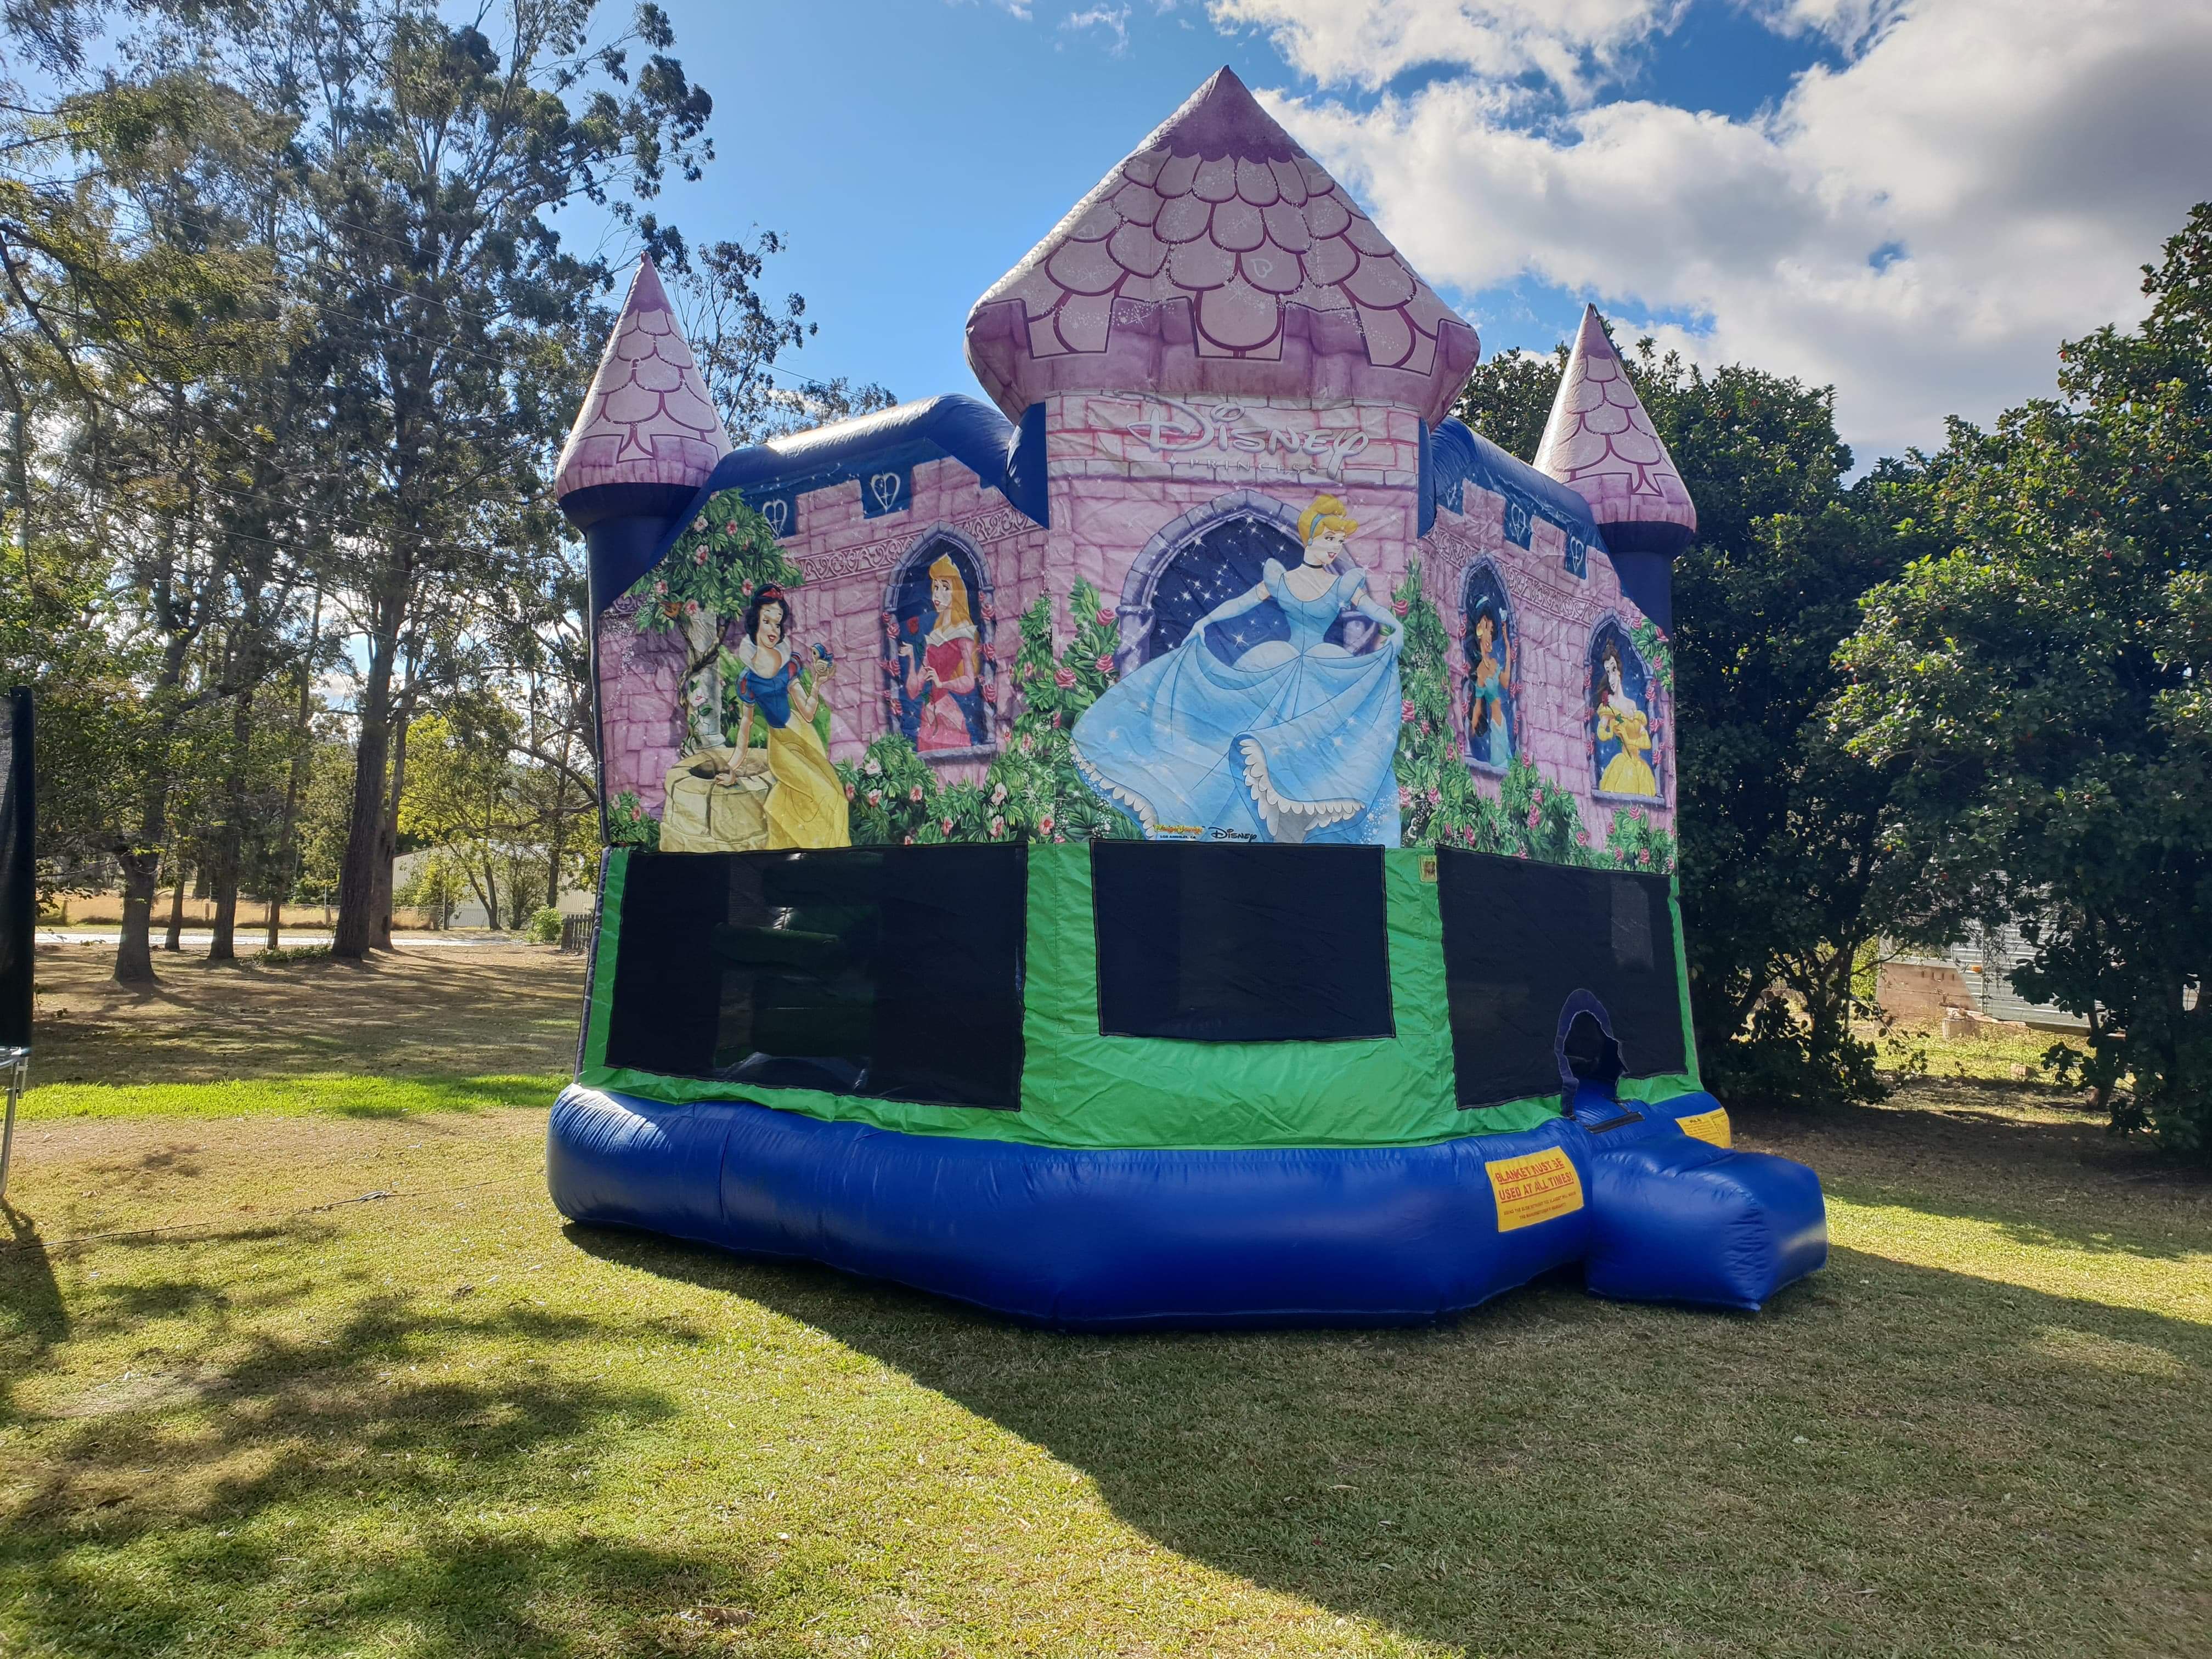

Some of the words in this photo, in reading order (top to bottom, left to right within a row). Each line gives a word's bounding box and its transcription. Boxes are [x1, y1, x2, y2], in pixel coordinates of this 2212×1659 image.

[1189, 458, 1318, 474] PRINCESS
[1495, 1166, 1531, 1183] BLANKET
[1498, 1187, 1521, 1200] USED
[1523, 1183, 1534, 1195] AT
[1535, 1180, 1549, 1192] ALL
[1549, 1171, 1574, 1187] TIMES!
